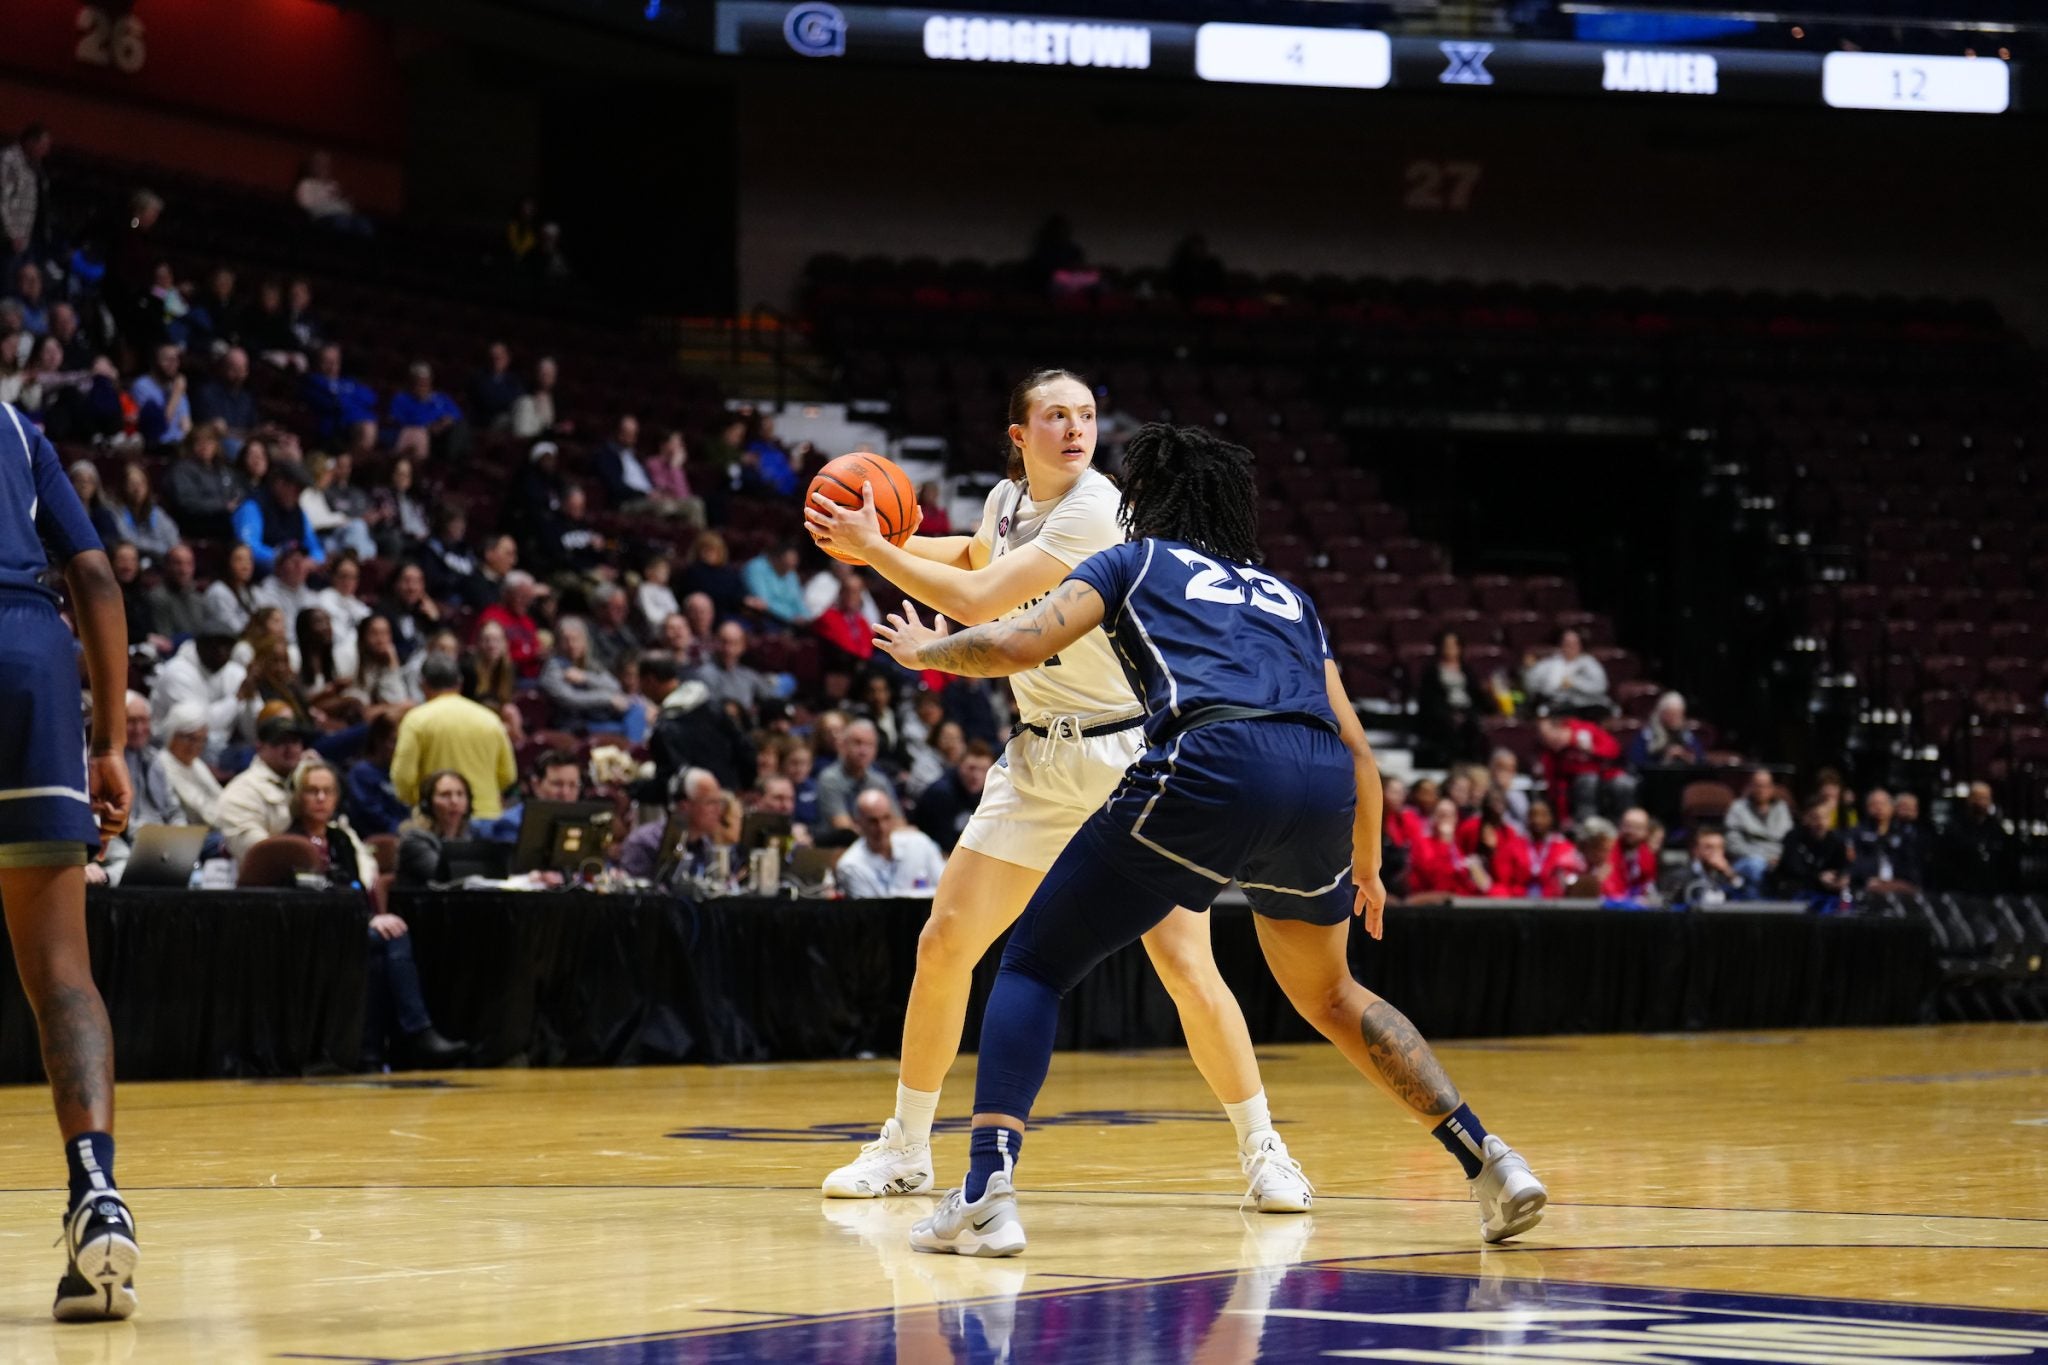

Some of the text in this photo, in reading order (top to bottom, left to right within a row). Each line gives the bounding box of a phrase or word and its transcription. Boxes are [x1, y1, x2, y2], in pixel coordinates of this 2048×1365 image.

[75, 4, 146, 74] 26
[925, 17, 1149, 68] GEORGETOWN
[1604, 51, 1716, 94] XAVIER
[1891, 67, 1928, 101] 12
[1404, 160, 1482, 210] 27
[1168, 548, 1303, 623] 23
